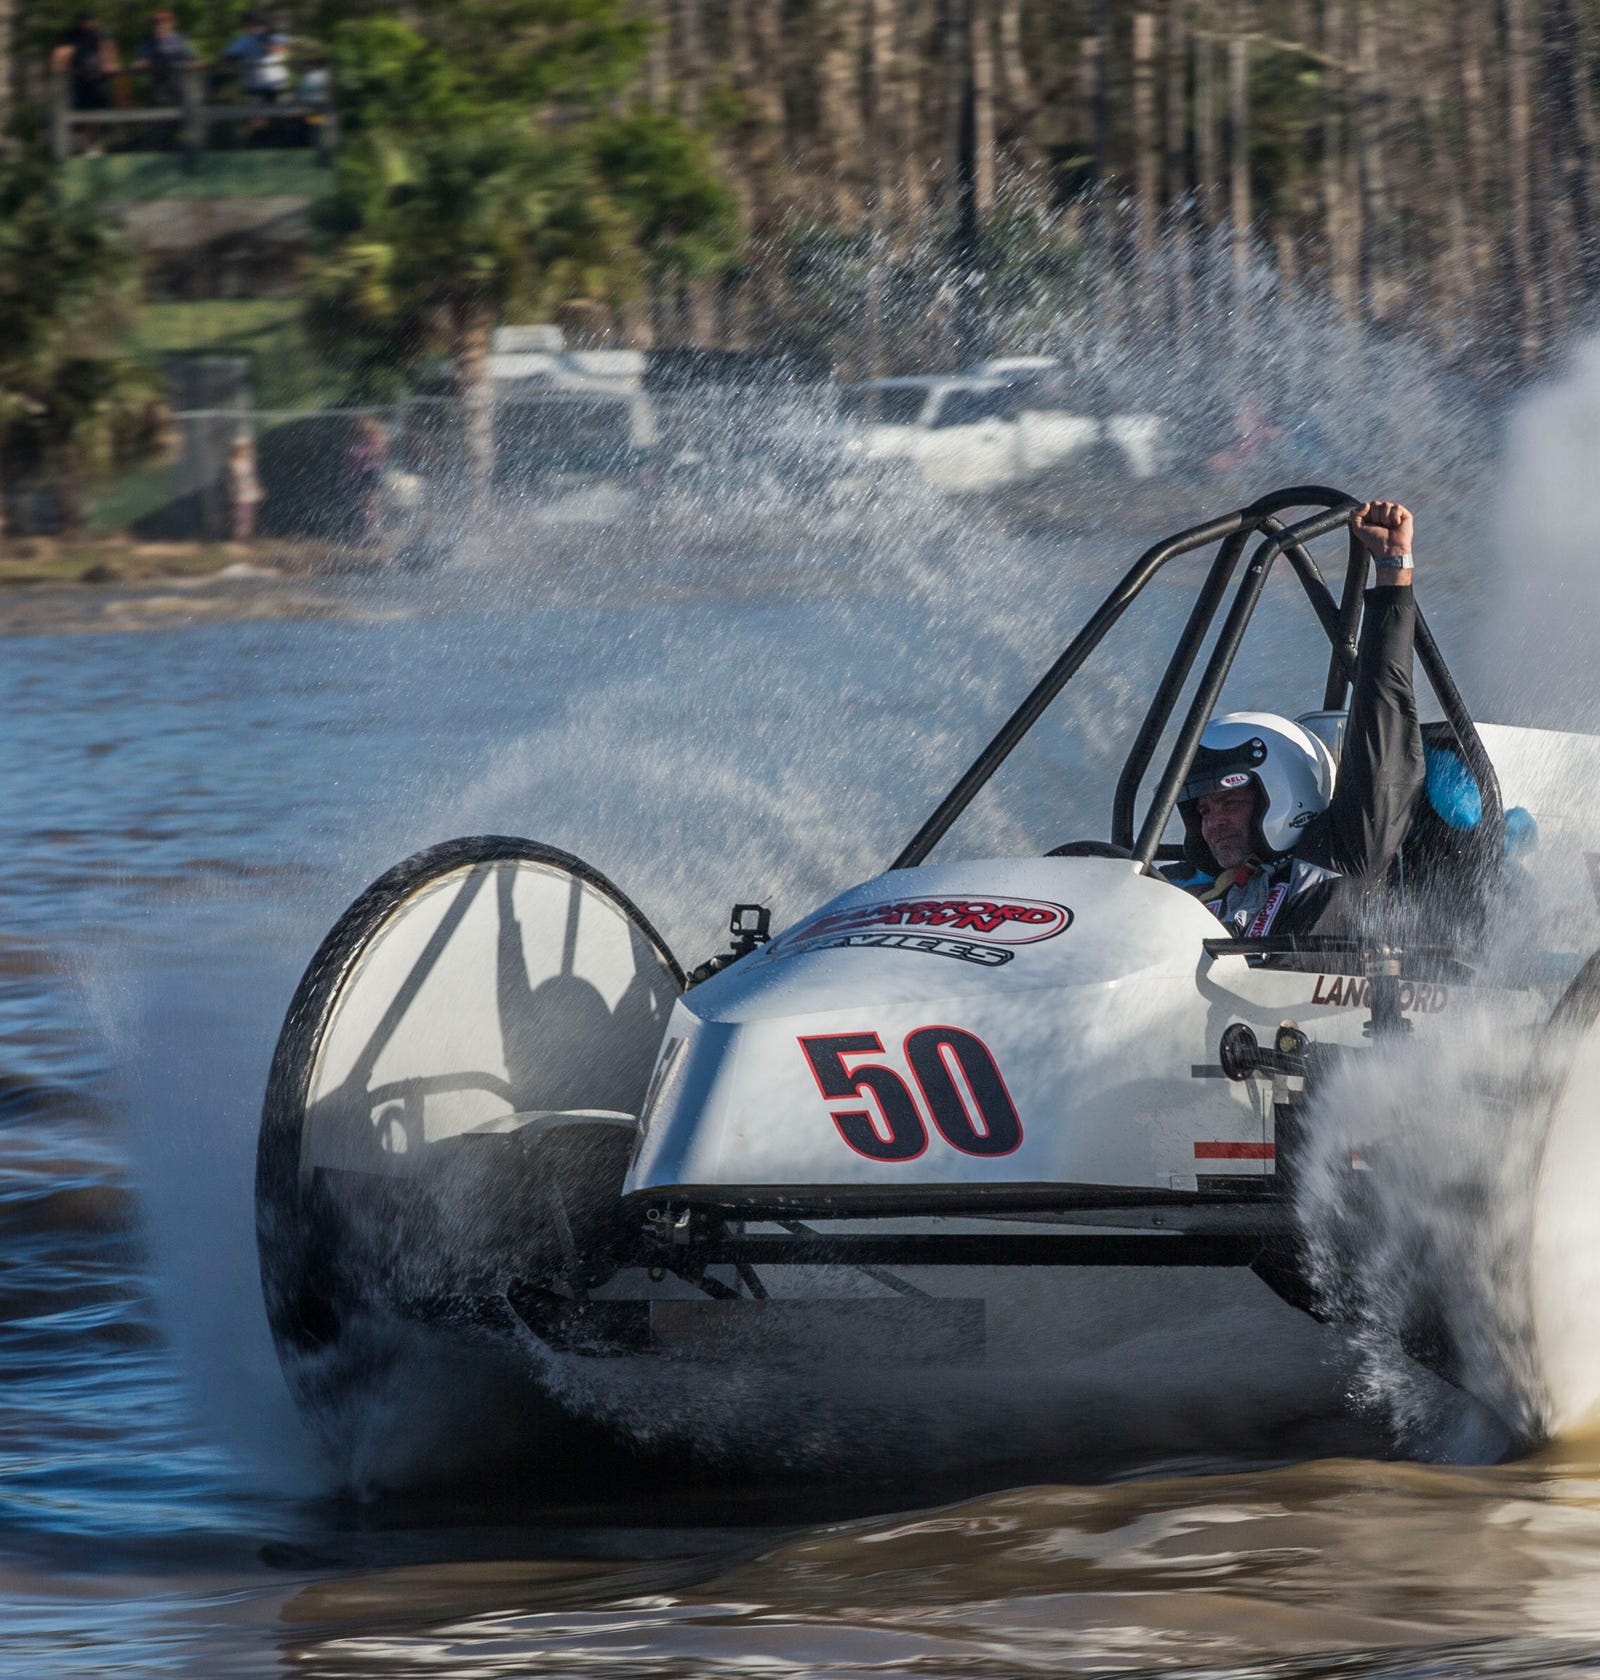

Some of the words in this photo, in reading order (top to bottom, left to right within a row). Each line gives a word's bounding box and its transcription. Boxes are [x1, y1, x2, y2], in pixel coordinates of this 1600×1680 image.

[1225, 775, 1246, 784] BELL
[1250, 889, 1281, 938] SIMPSON
[796, 1024, 1024, 1163] 50
